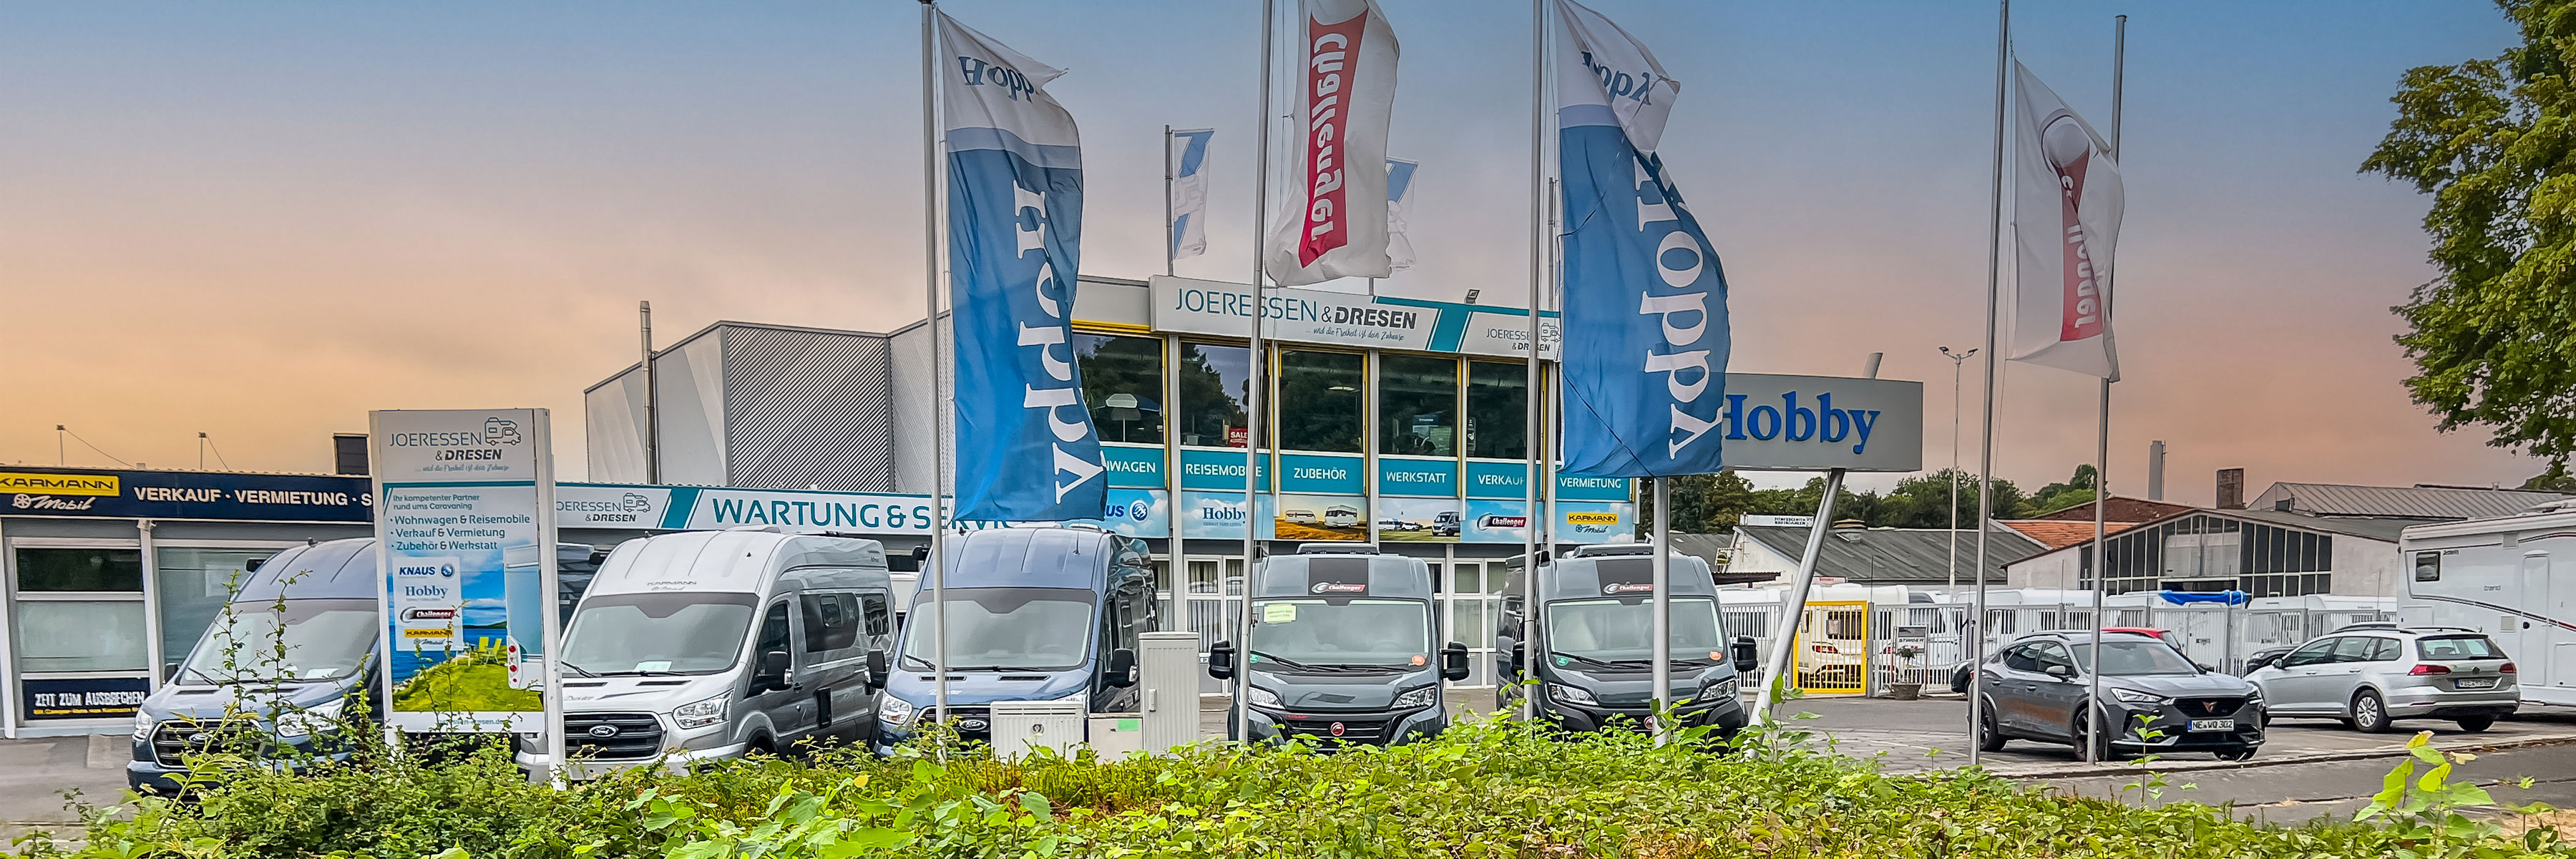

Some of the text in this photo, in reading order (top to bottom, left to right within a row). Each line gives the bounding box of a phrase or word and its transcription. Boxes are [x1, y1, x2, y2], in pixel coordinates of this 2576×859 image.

[1321, 306, 1332, 323] &
[1335, 306, 1417, 329] DRESEN
[1518, 342, 1551, 351] DREN
[390, 432, 482, 447] JOERESSEN
[435, 449, 502, 461] & DRESEN
[1294, 467, 1347, 480] ZUBEHÖR
[1386, 472, 1446, 483] WERKSTATT
[1560, 477, 1621, 489] VERMIETUNG
[134, 487, 222, 503] VERKAUF
[235, 490, 348, 505] VERMIETUNG
[556, 501, 621, 512] OERESSEN
[713, 498, 879, 528] WARTUNG
[887, 505, 907, 528] &
[395, 515, 458, 525] Wohnwagen
[469, 514, 530, 524] Reisemobile
[1492, 518, 1524, 527] Challenger
[396, 528, 505, 538] Verkauf & Vermietung
[396, 541, 438, 550] Zubehör
[449, 540, 497, 550] Werkstatt
[399, 566, 436, 576] KNAUS
[405, 585, 449, 599] Hobby
